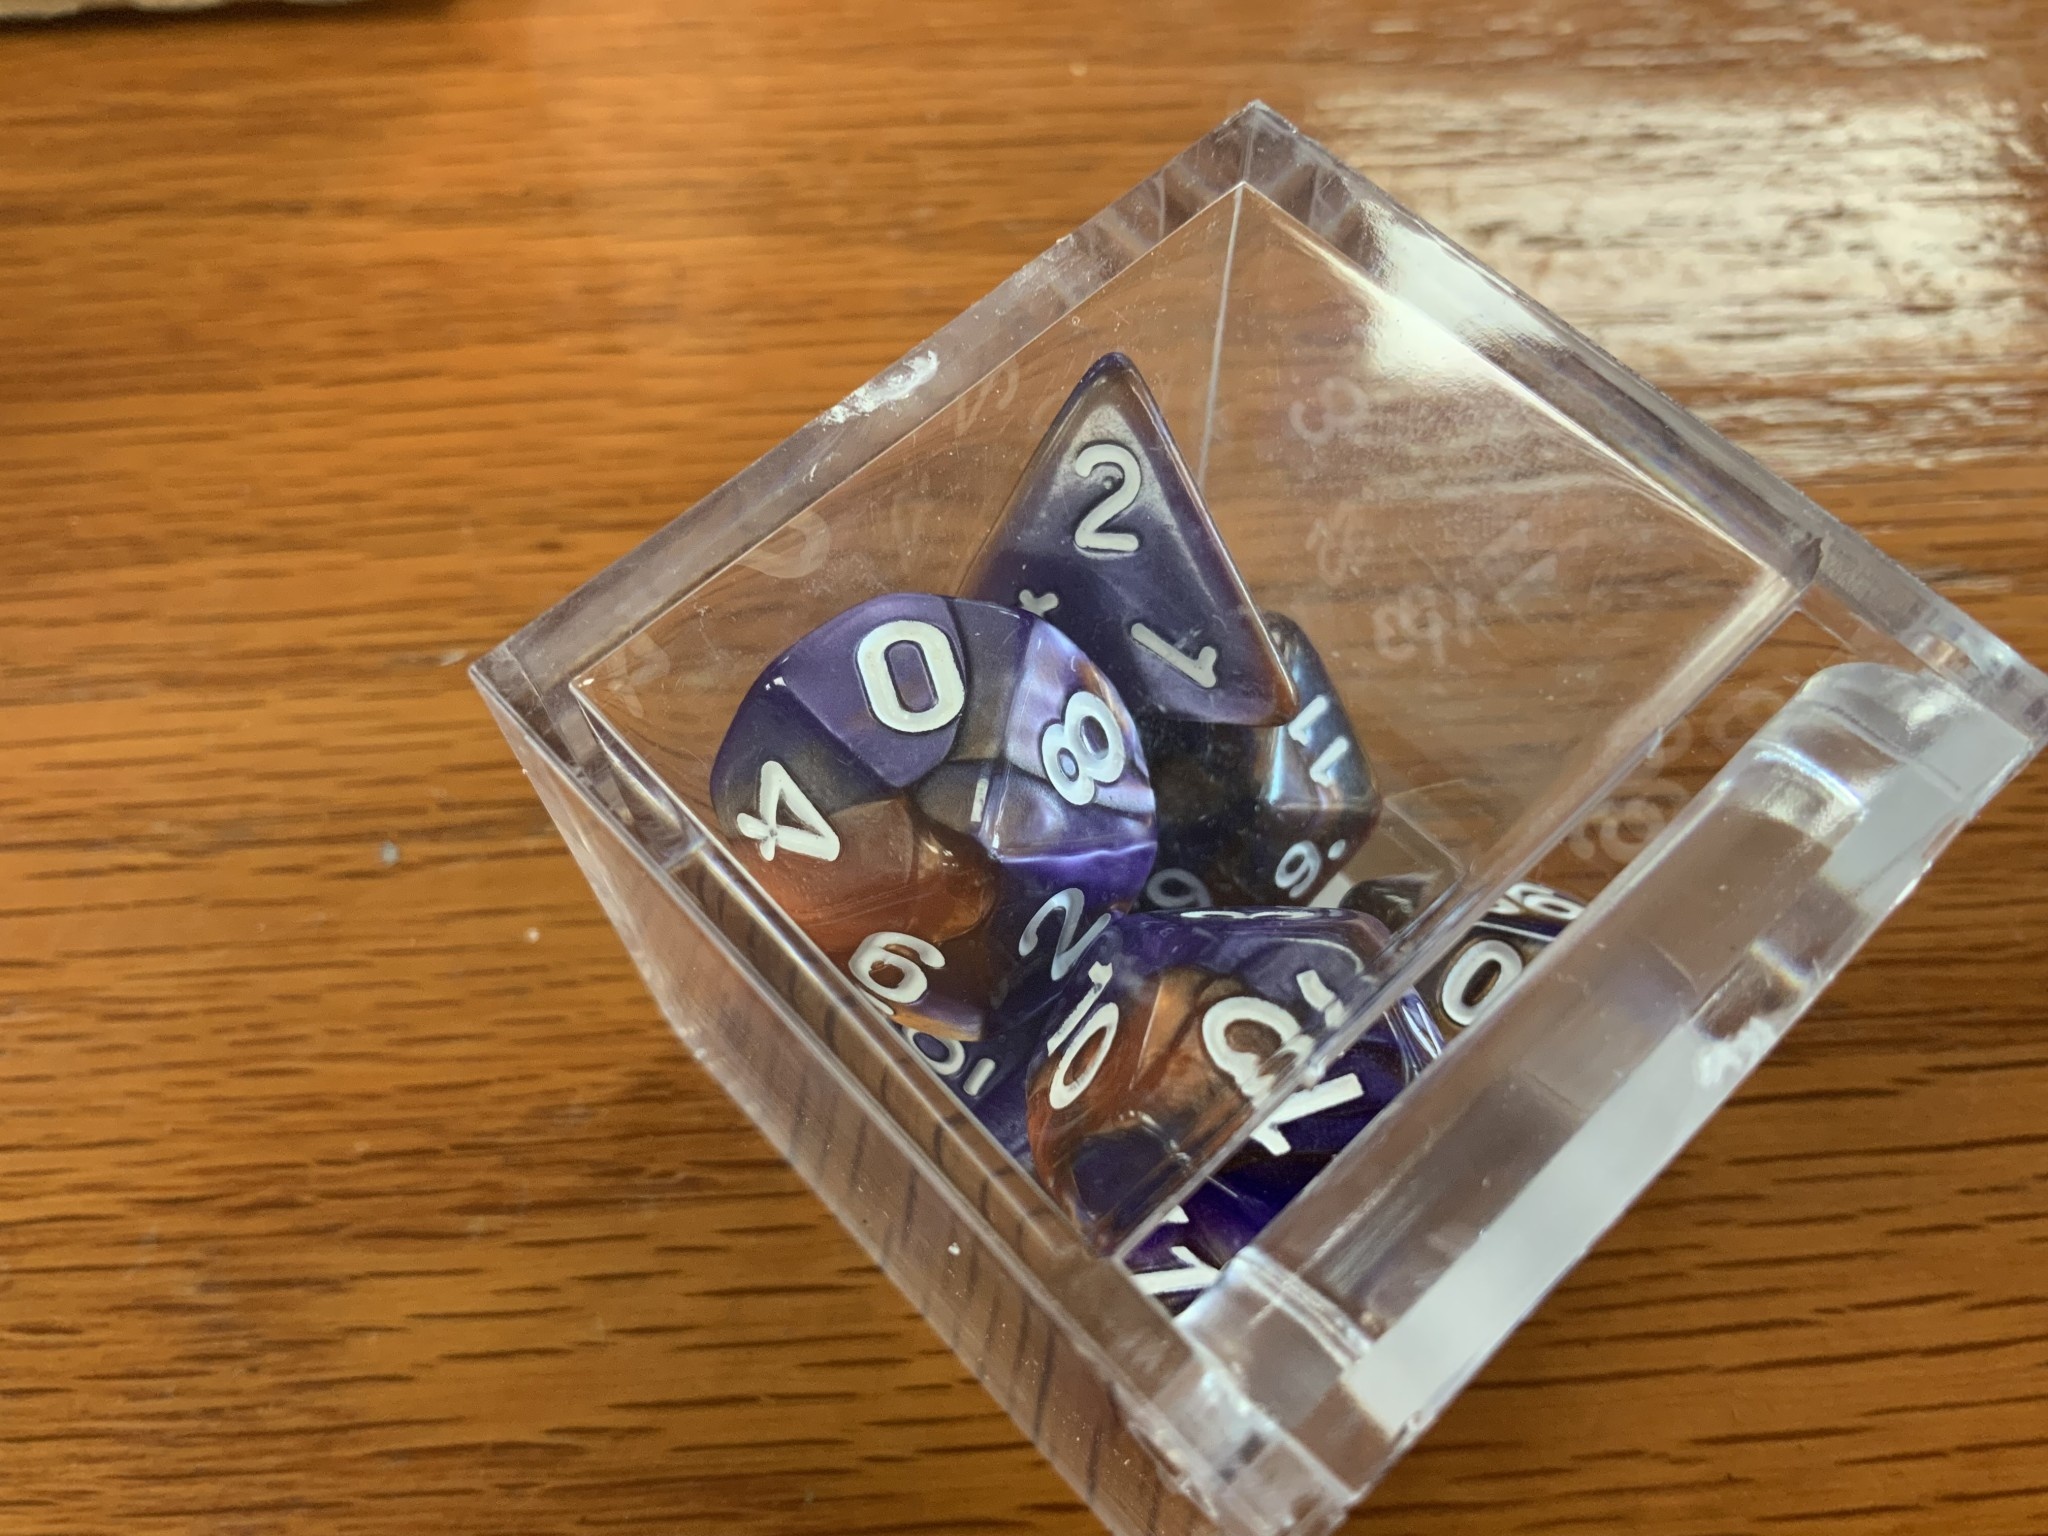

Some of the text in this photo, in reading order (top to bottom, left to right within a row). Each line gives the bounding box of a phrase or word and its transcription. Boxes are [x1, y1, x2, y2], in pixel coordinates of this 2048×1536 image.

[1074, 443, 1142, 552] 2
[857, 620, 965, 733] 0
[1130, 622, 1217, 688] 1
[1042, 690, 1124, 806] 8
[737, 760, 840, 862] 4
[1018, 888, 1111, 981] 2
[1047, 961, 1119, 1110] 10
